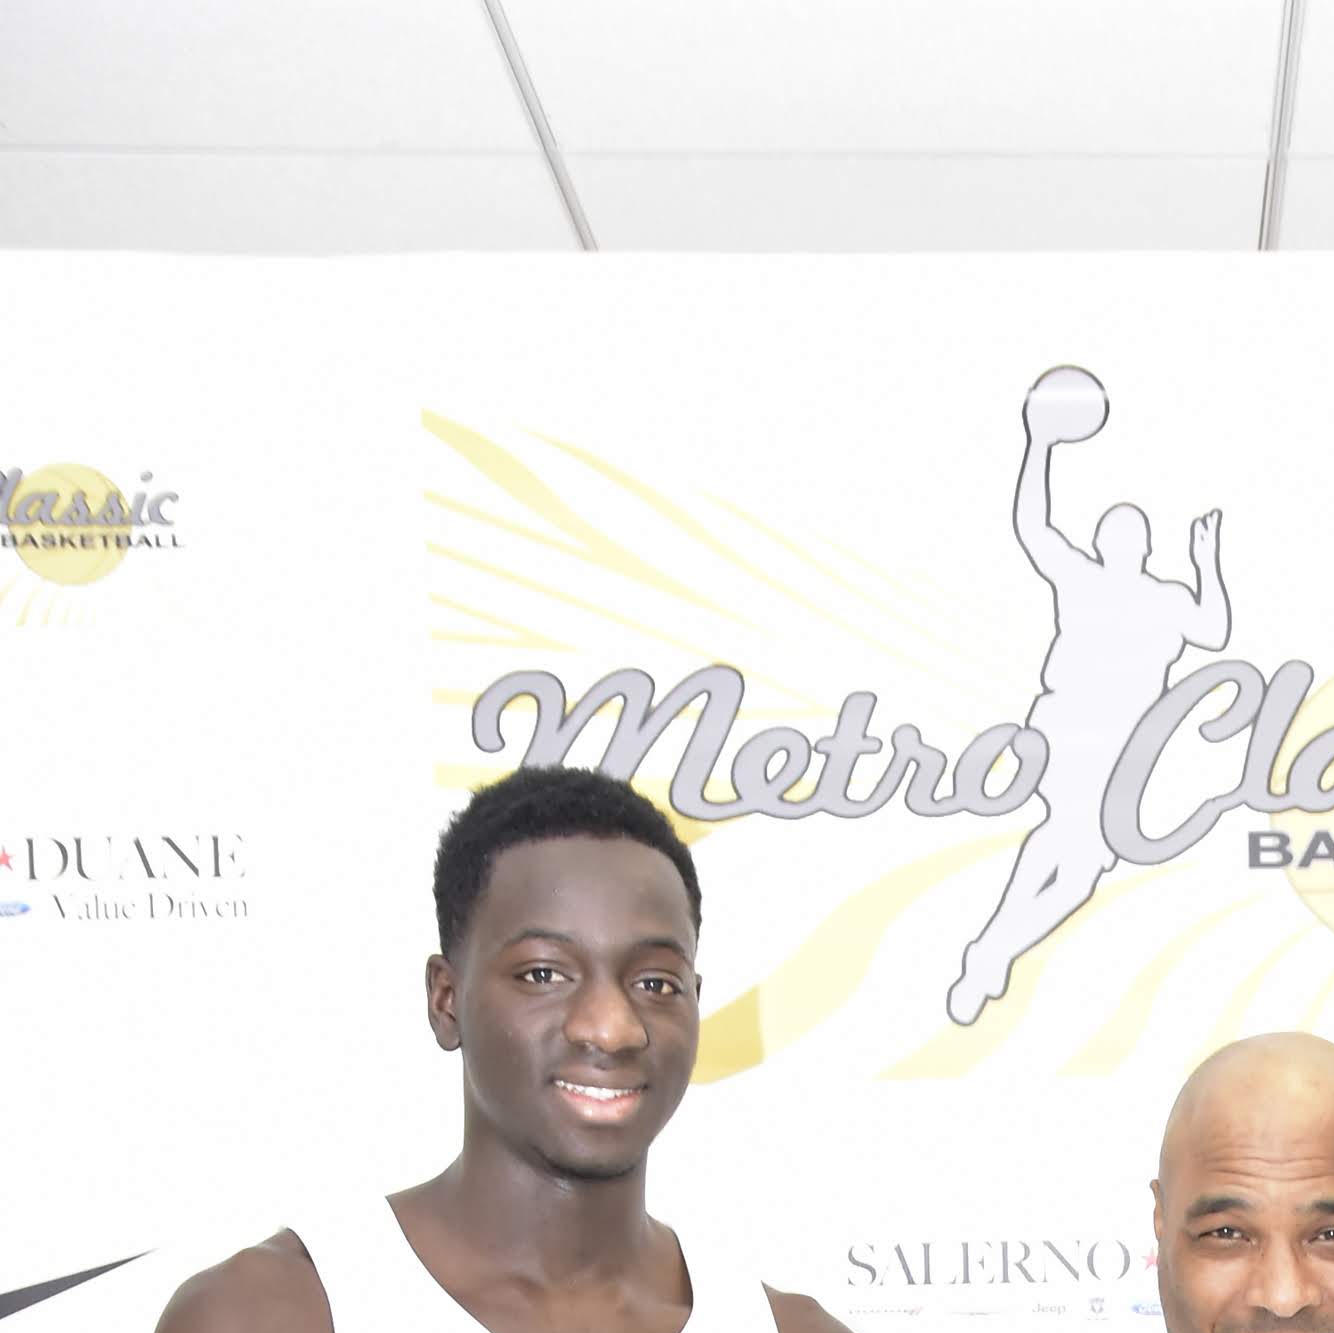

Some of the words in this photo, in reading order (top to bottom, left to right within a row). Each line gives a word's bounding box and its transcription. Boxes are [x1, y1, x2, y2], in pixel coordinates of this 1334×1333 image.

[0, 467, 180, 527] lassic
[1, 533, 185, 549] BASKETBALL
[472, 664, 1050, 820] Metro
[846, 1240, 1132, 1287] SALERNO
